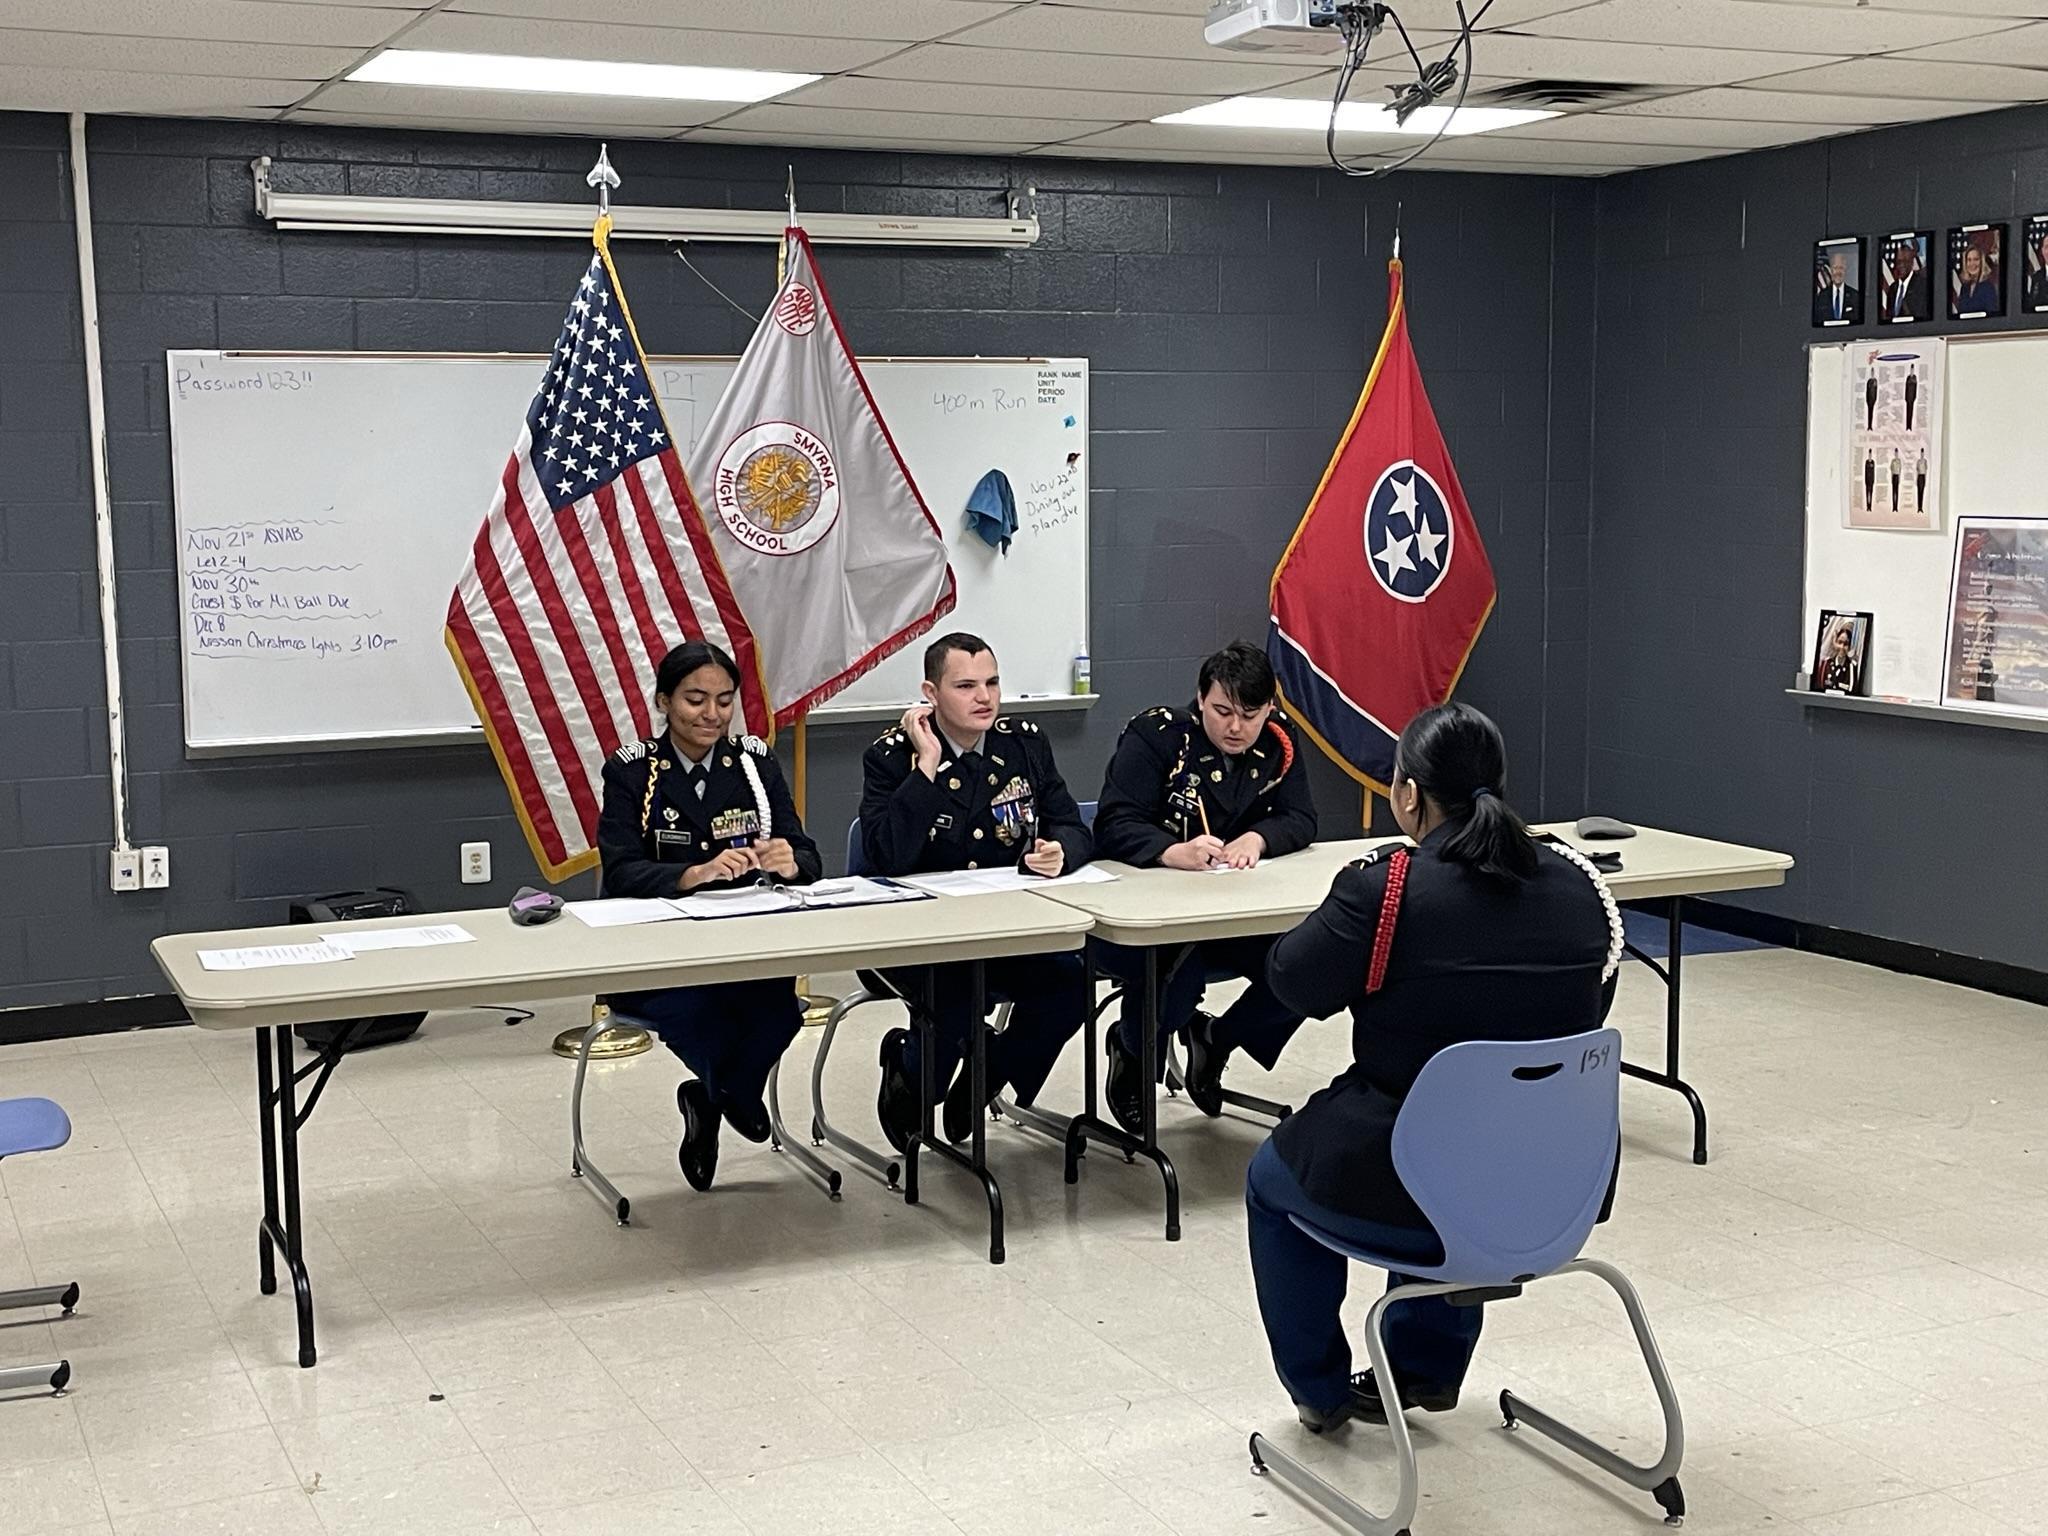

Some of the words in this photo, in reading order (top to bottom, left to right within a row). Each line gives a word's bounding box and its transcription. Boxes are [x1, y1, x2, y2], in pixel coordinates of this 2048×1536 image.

[792, 289, 815, 324] ARMY
[1037, 371, 1058, 379] RANK
[1061, 371, 1082, 379] NAME
[1037, 379, 1056, 387] UNIT
[992, 388, 1026, 411] Run
[1037, 388, 1065, 396] PERIOD
[1037, 396, 1057, 404] DATE
[794, 432, 836, 490] SMYRNA
[1030, 479, 1055, 494] Nov
[720, 468, 734, 507] HIGH
[729, 514, 788, 550] SCHOOL
[187, 534, 221, 551] Nov
[191, 575, 219, 590] Nov
[294, 594, 322, 609] Ball
[327, 594, 350, 609] Due
